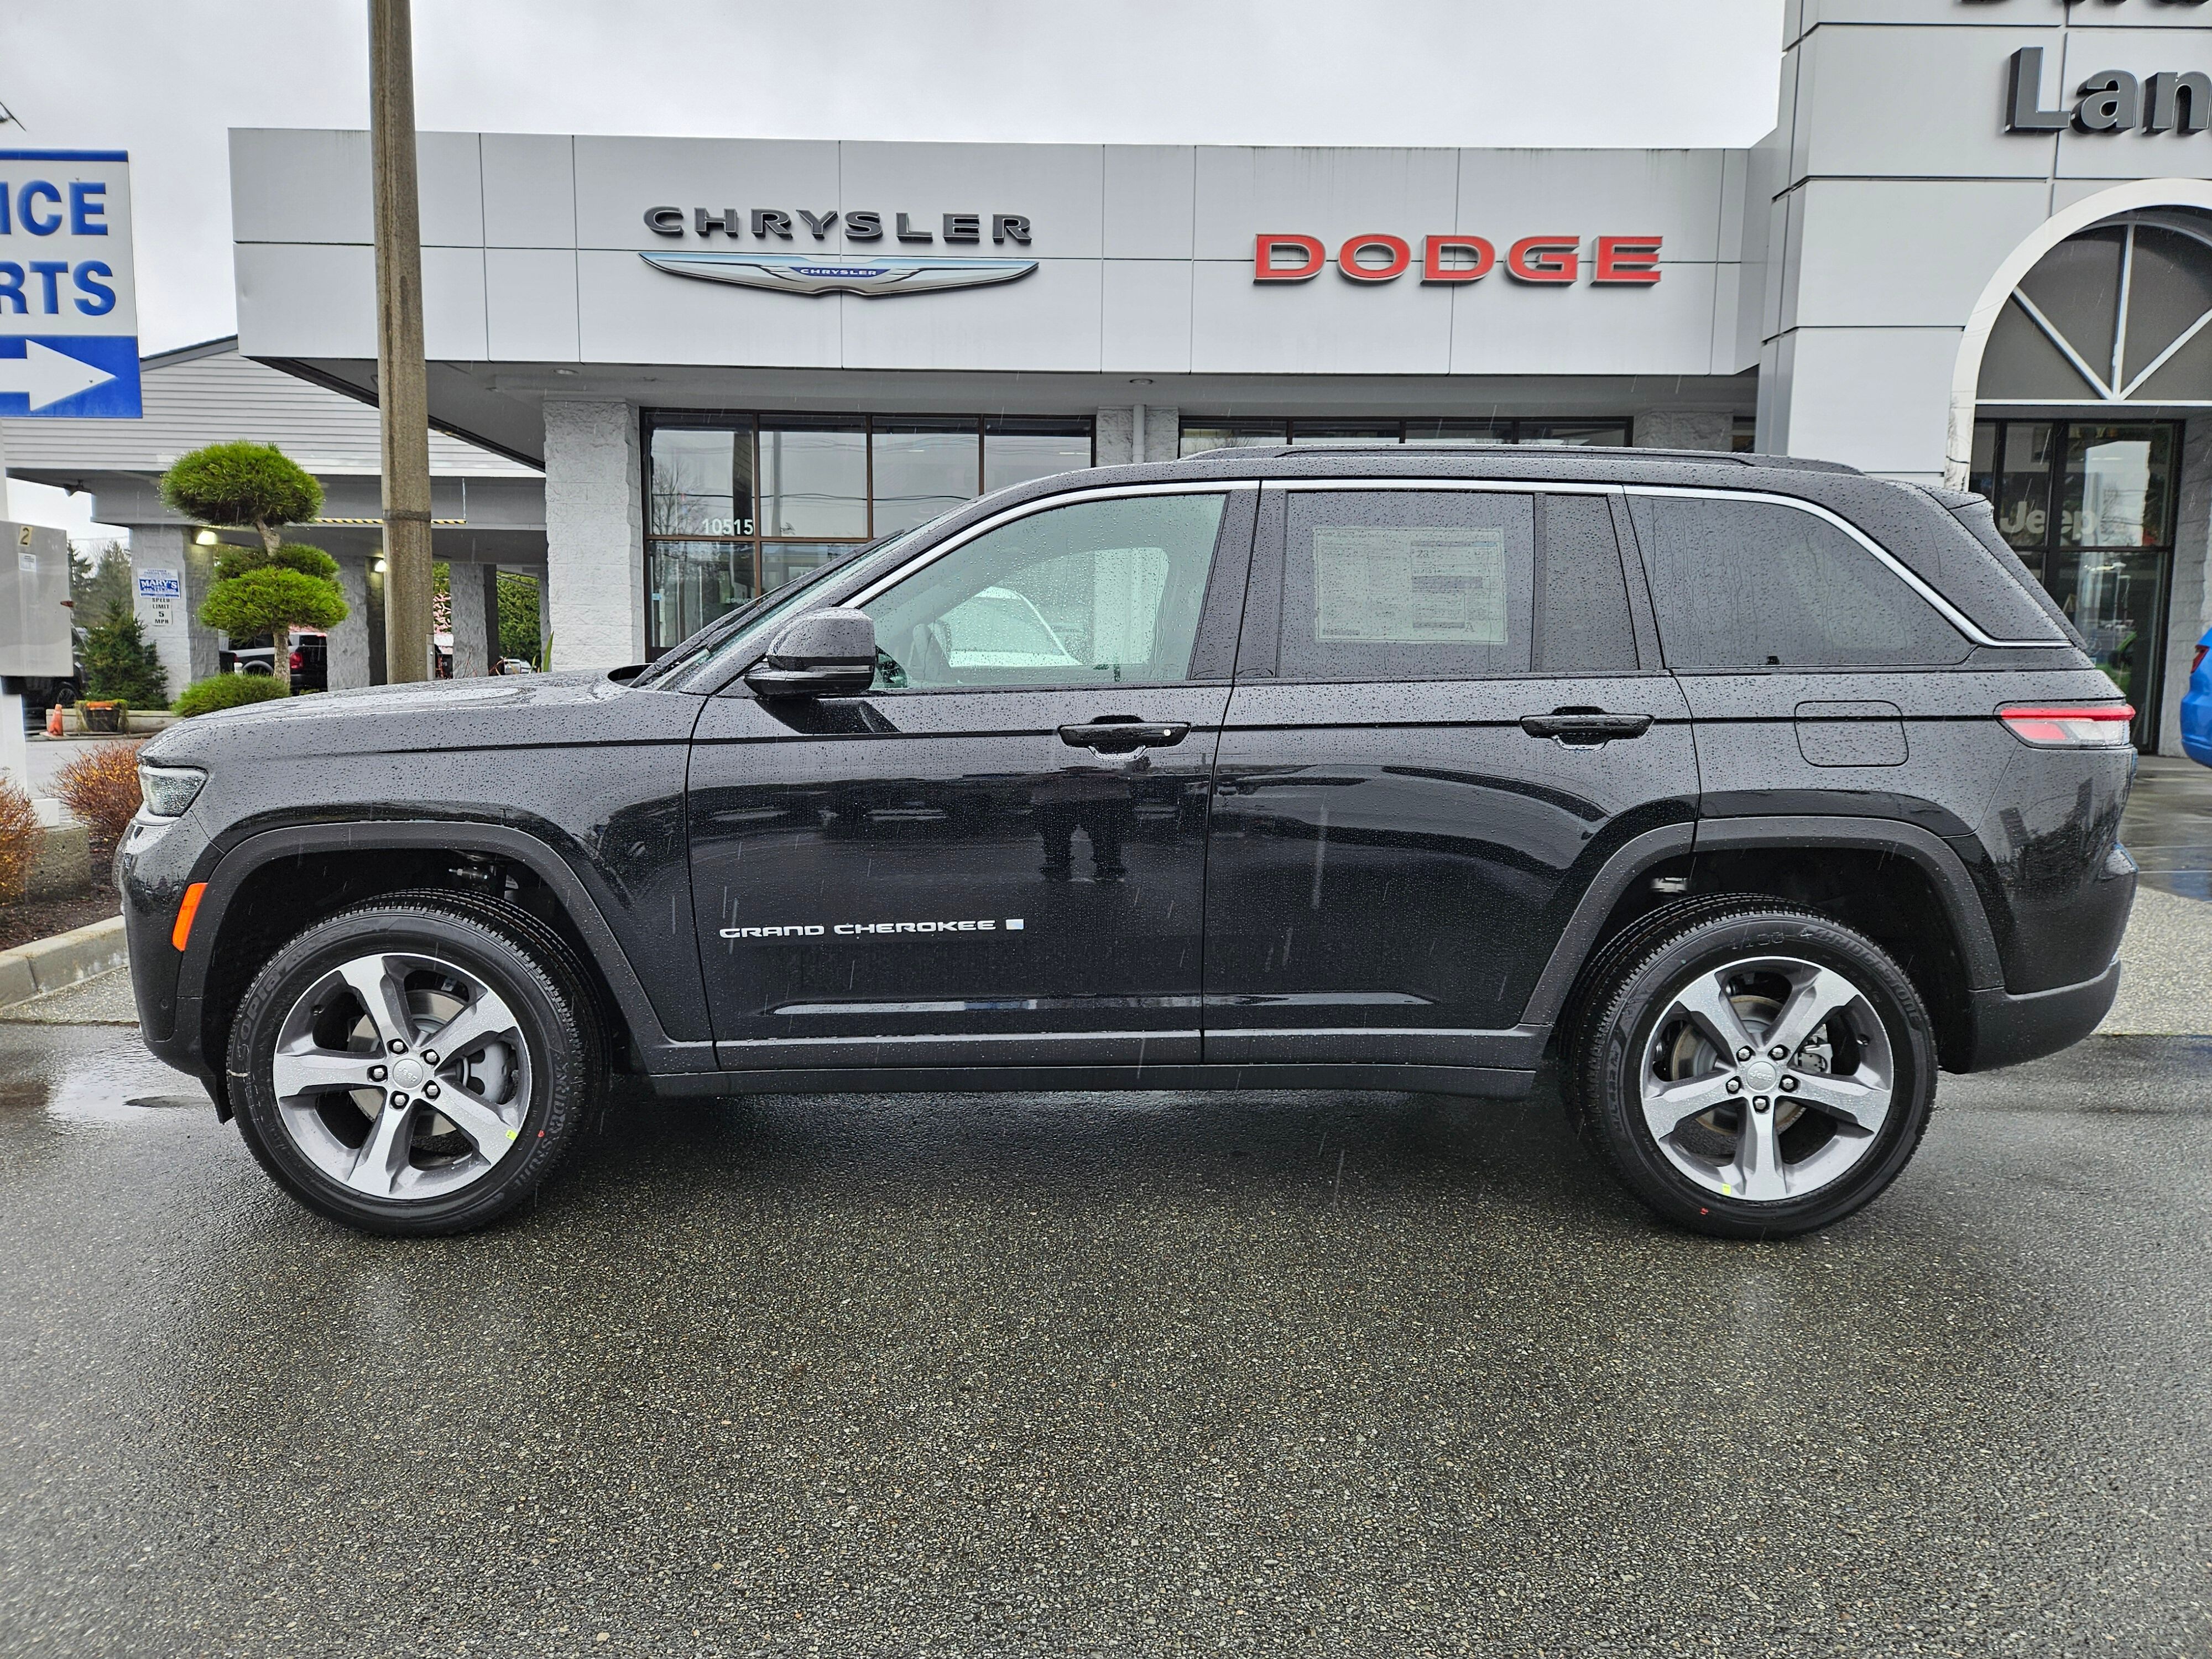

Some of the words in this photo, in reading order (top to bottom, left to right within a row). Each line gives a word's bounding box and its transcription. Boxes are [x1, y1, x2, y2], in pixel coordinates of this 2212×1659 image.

[643, 205, 1032, 244] CHRYSLER
[1253, 233, 1664, 286] DODGE
[702, 518, 754, 535] 10515
[1999, 500, 2096, 541] Jeep
[20, 527, 30, 545] 2
[140, 579, 178, 589] MARY'S
[719, 925, 825, 938] GRAND
[834, 920, 996, 935] CHEROKEE
[1749, 1070, 1773, 1083] Jeep
